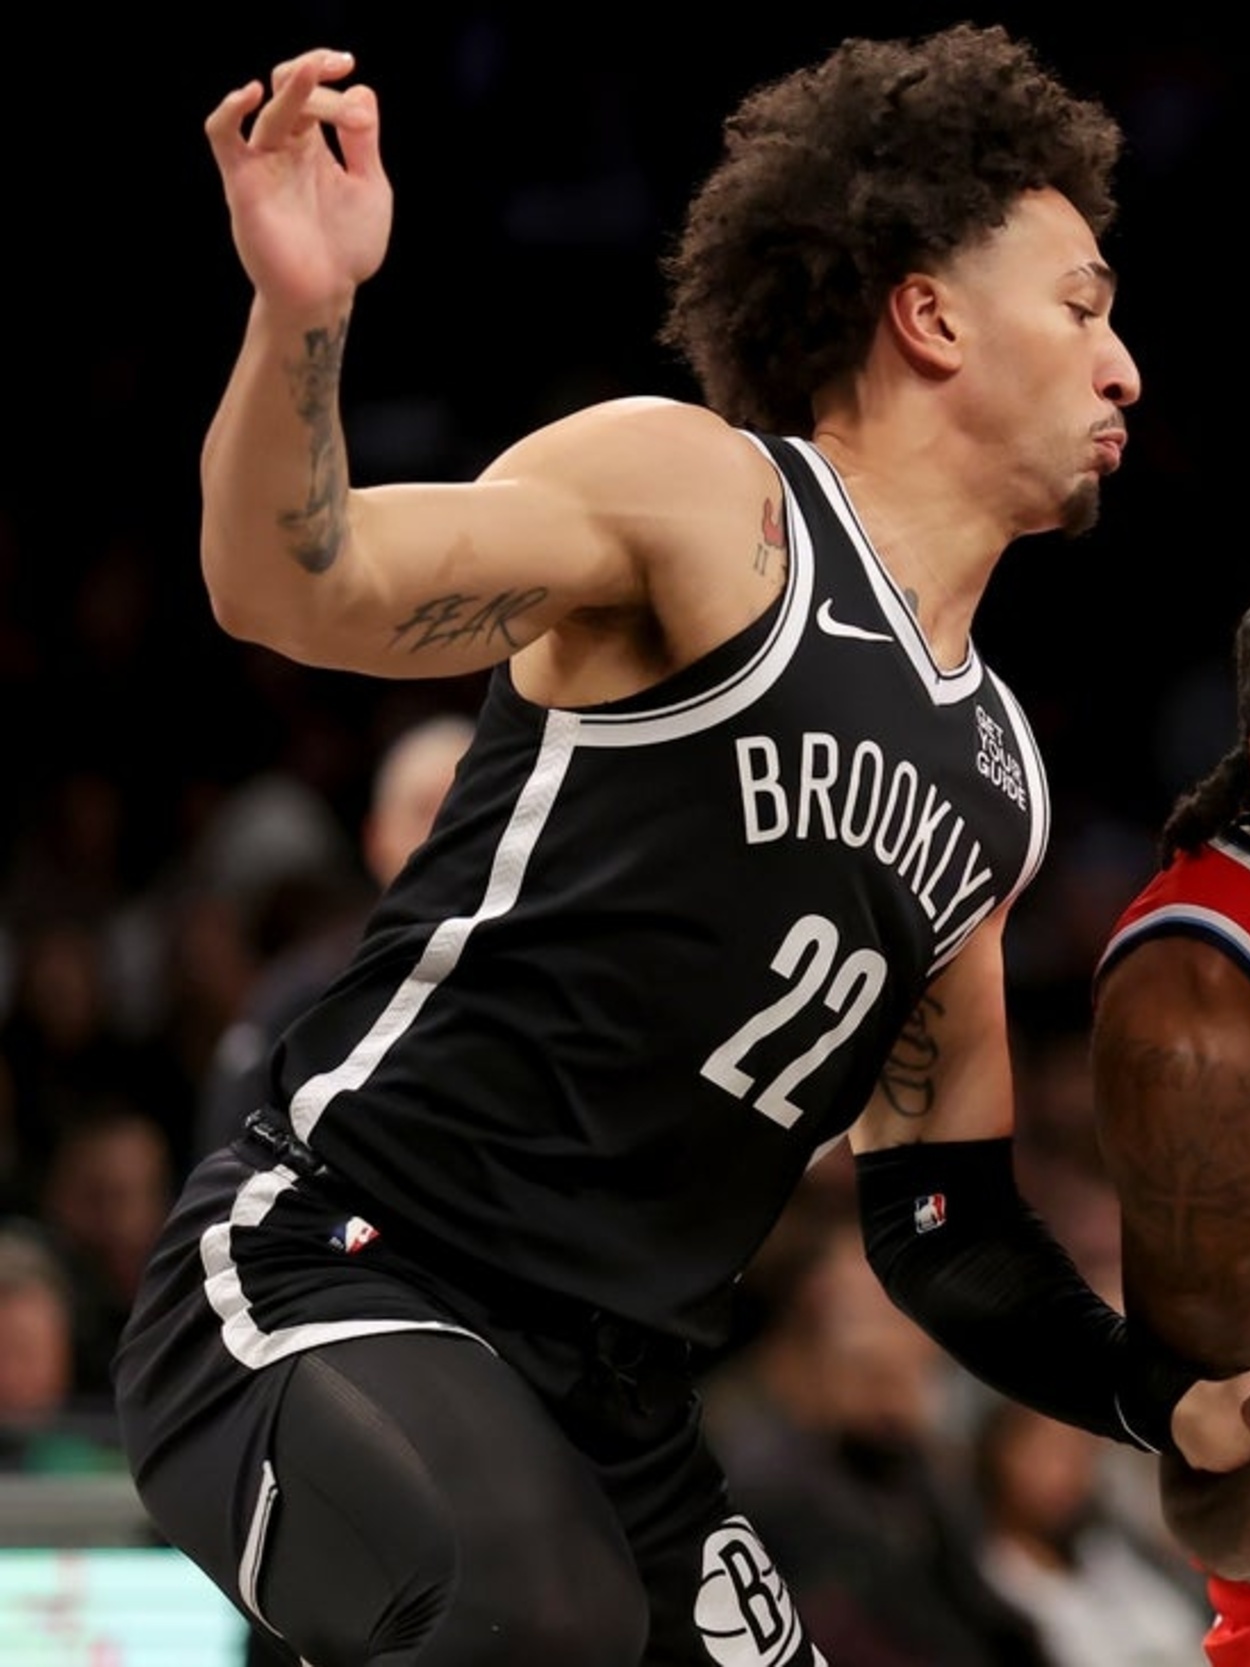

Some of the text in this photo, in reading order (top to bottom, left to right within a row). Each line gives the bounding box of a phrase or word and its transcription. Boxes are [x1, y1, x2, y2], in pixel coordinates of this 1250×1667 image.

[976, 750, 1027, 811] GUIDE
[700, 914, 887, 1129] 22
[718, 1539, 784, 1655] B
